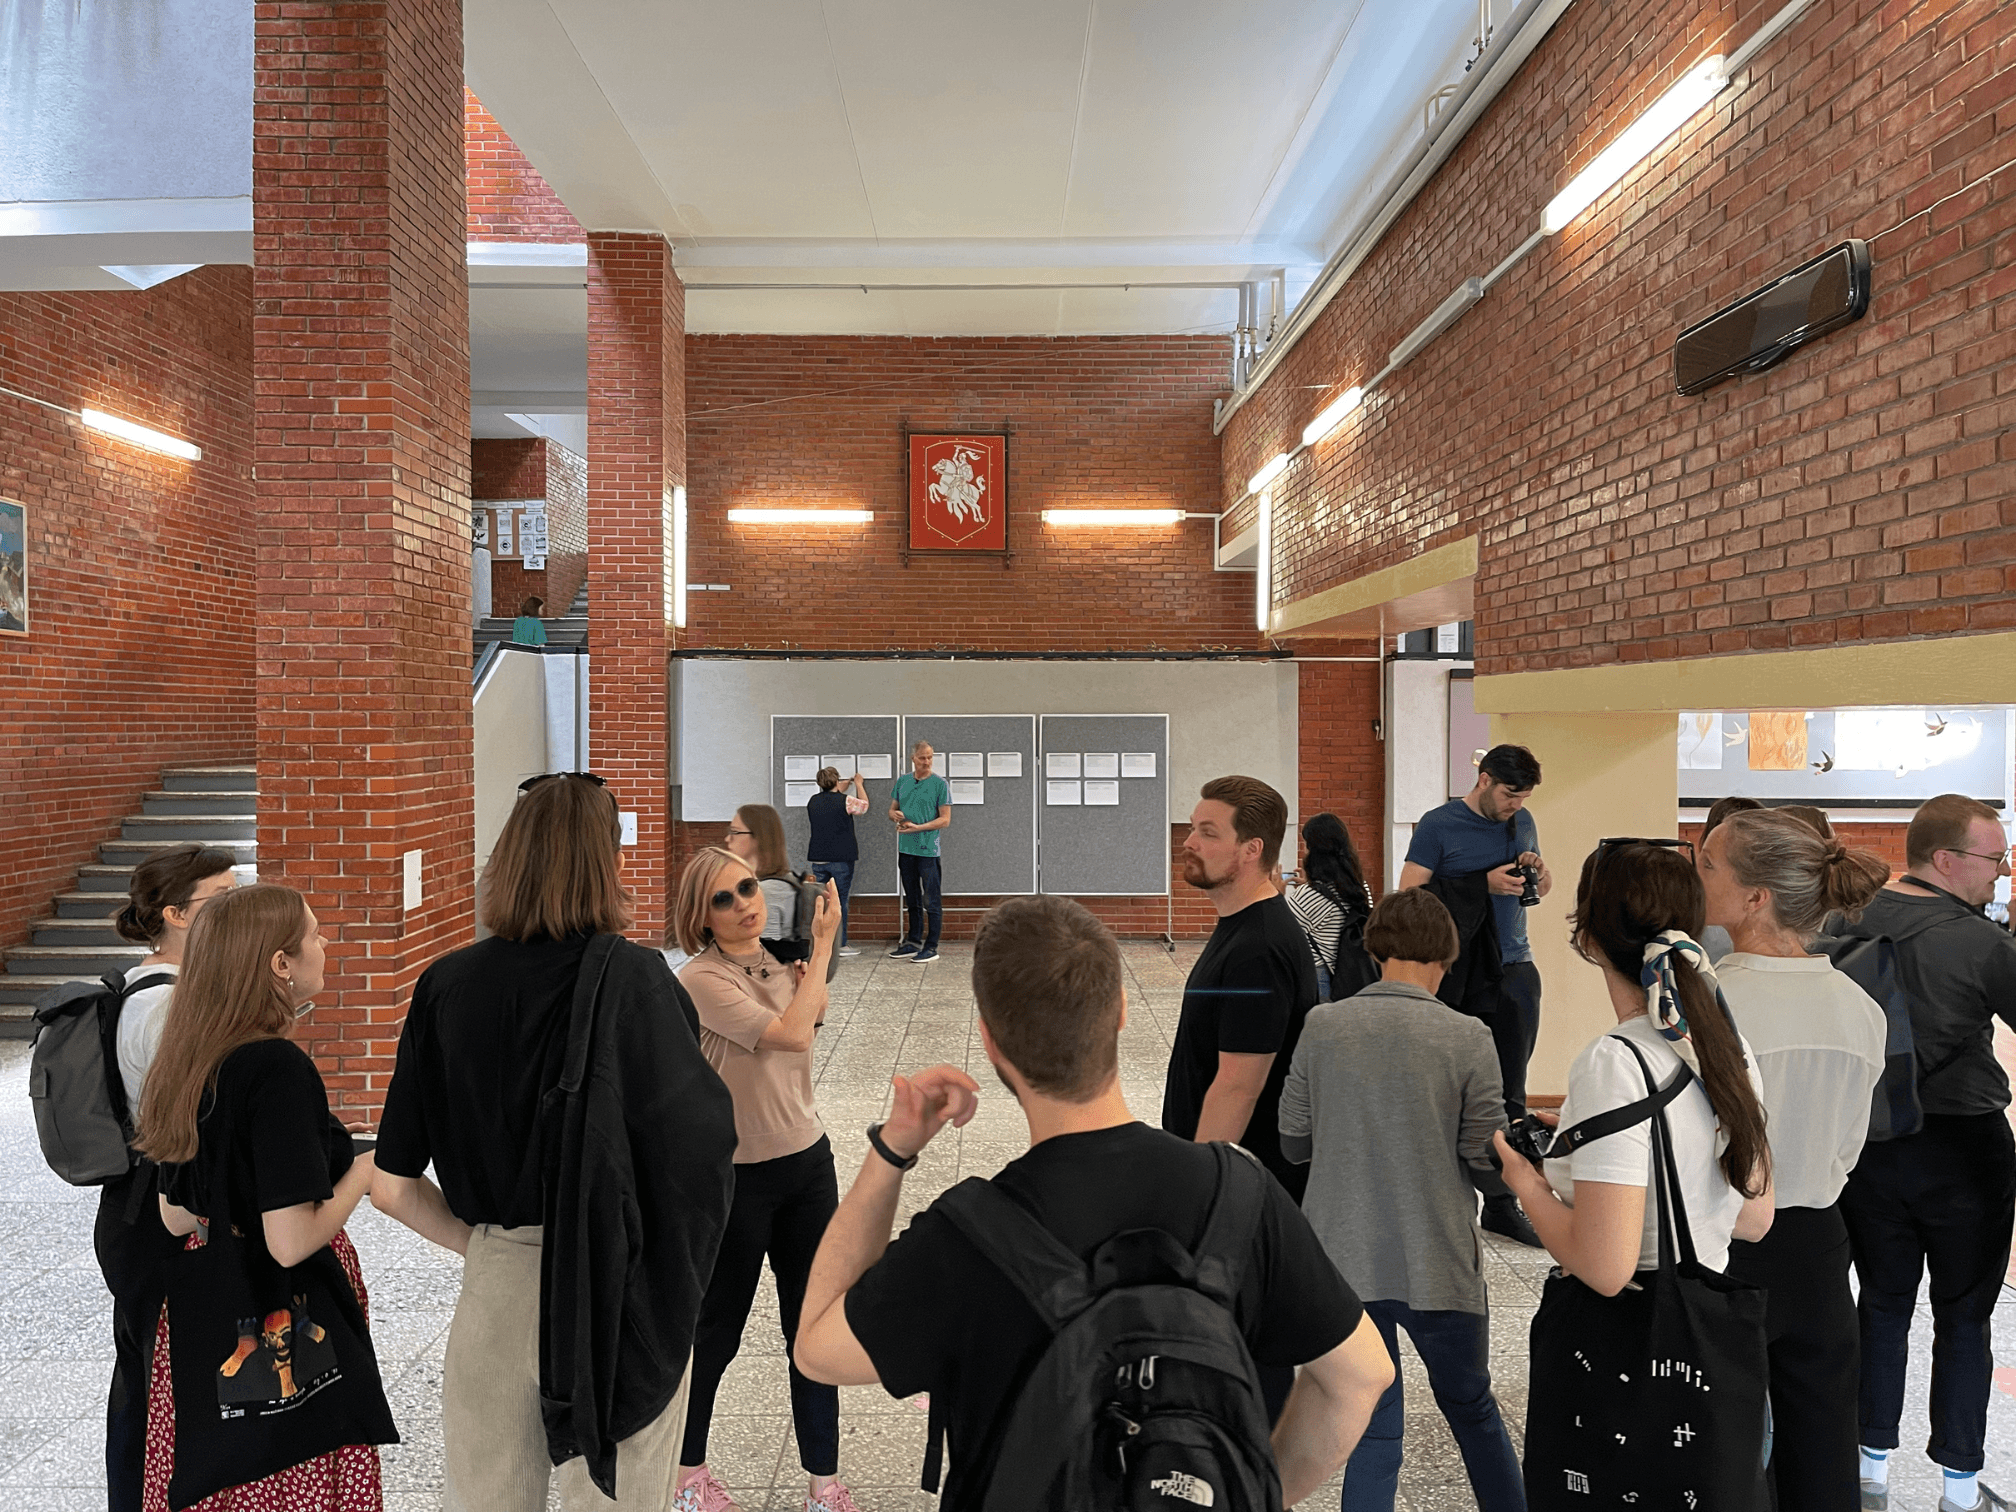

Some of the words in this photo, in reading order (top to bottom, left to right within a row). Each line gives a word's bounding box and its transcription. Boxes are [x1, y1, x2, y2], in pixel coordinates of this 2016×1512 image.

[1170, 1470, 1195, 1484] THE
[1151, 1479, 1192, 1493] NORTH
[1161, 1487, 1192, 1501] FACE
